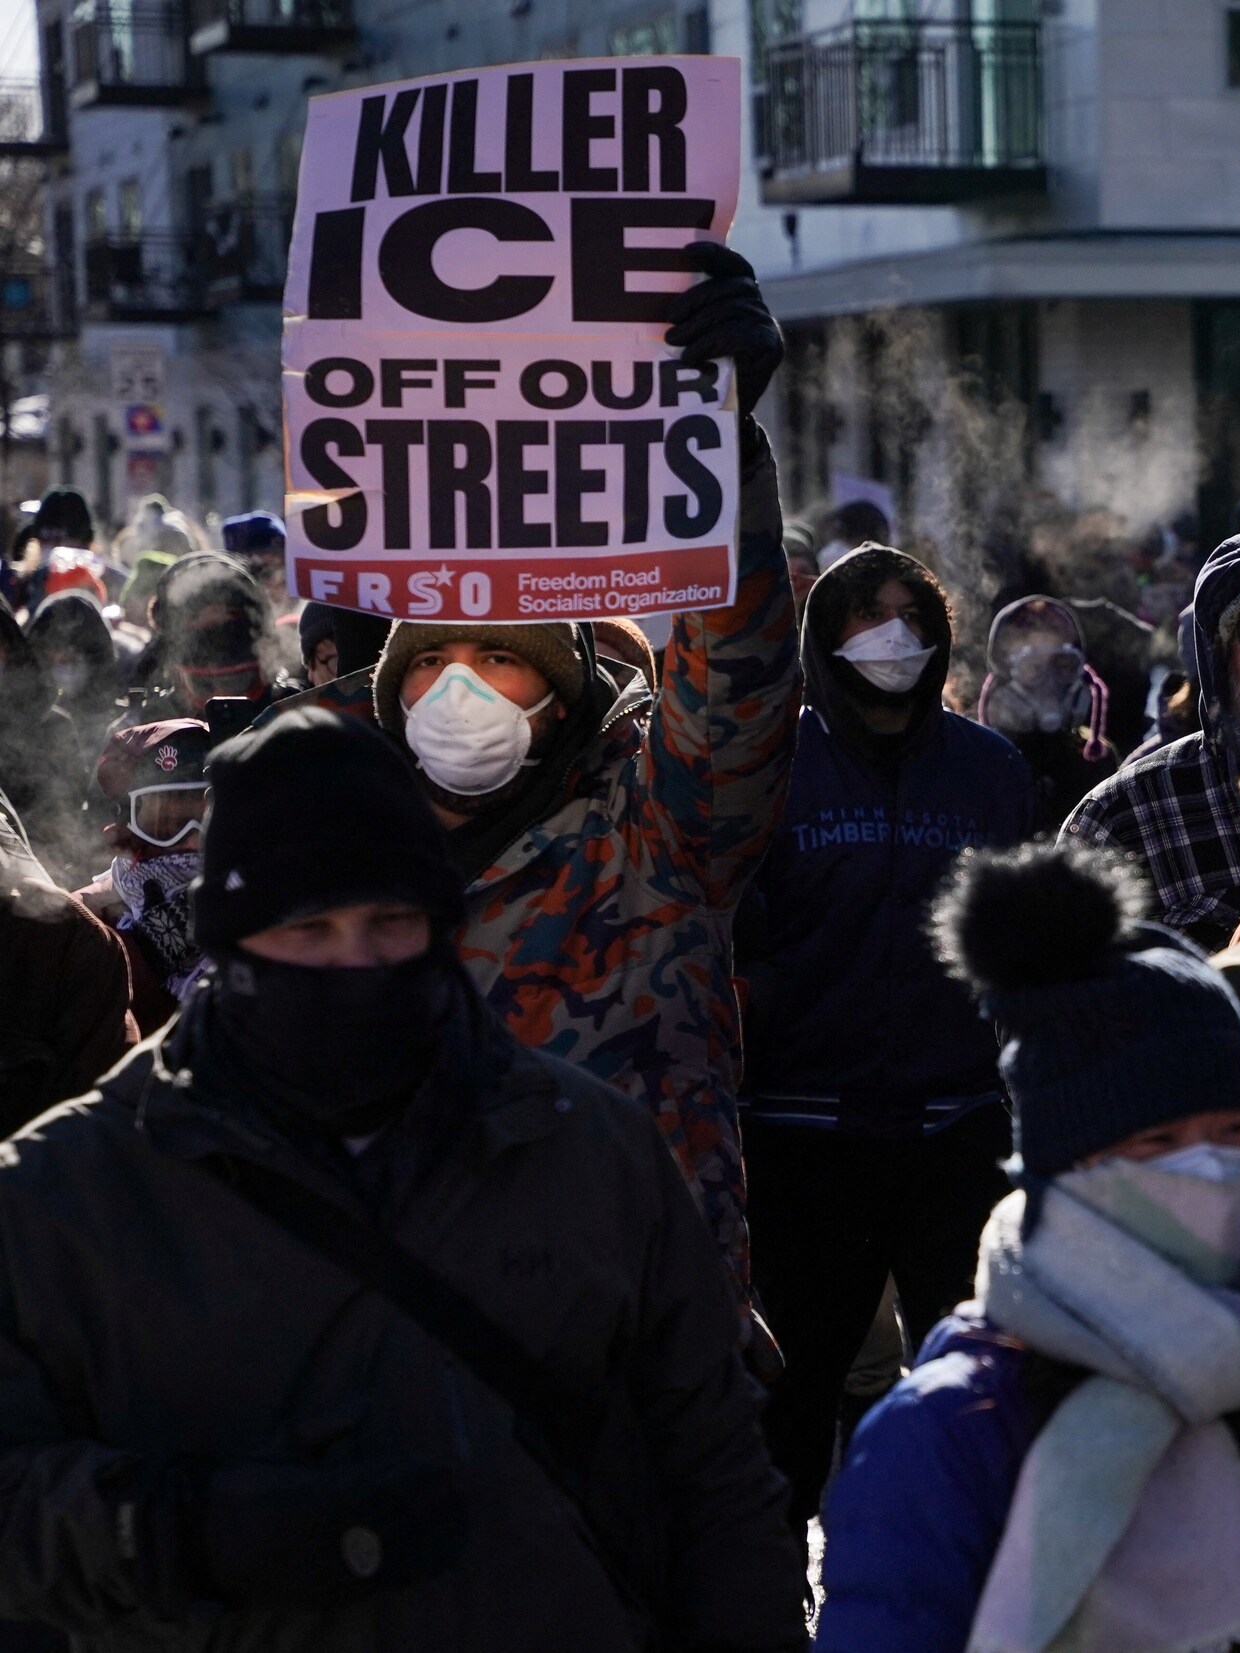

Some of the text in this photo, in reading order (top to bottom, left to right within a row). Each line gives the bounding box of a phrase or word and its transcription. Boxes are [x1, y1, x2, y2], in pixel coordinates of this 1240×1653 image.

[350, 66, 688, 202] KILLER
[307, 197, 716, 324] ICE
[304, 357, 720, 410] OFF OUR
[301, 414, 724, 551] STREETS
[309, 570, 493, 616] FRSO
[517, 566, 660, 591] Freedom Road
[518, 584, 721, 613] Socialist Organization
[820, 807, 977, 828] MINNESOTA
